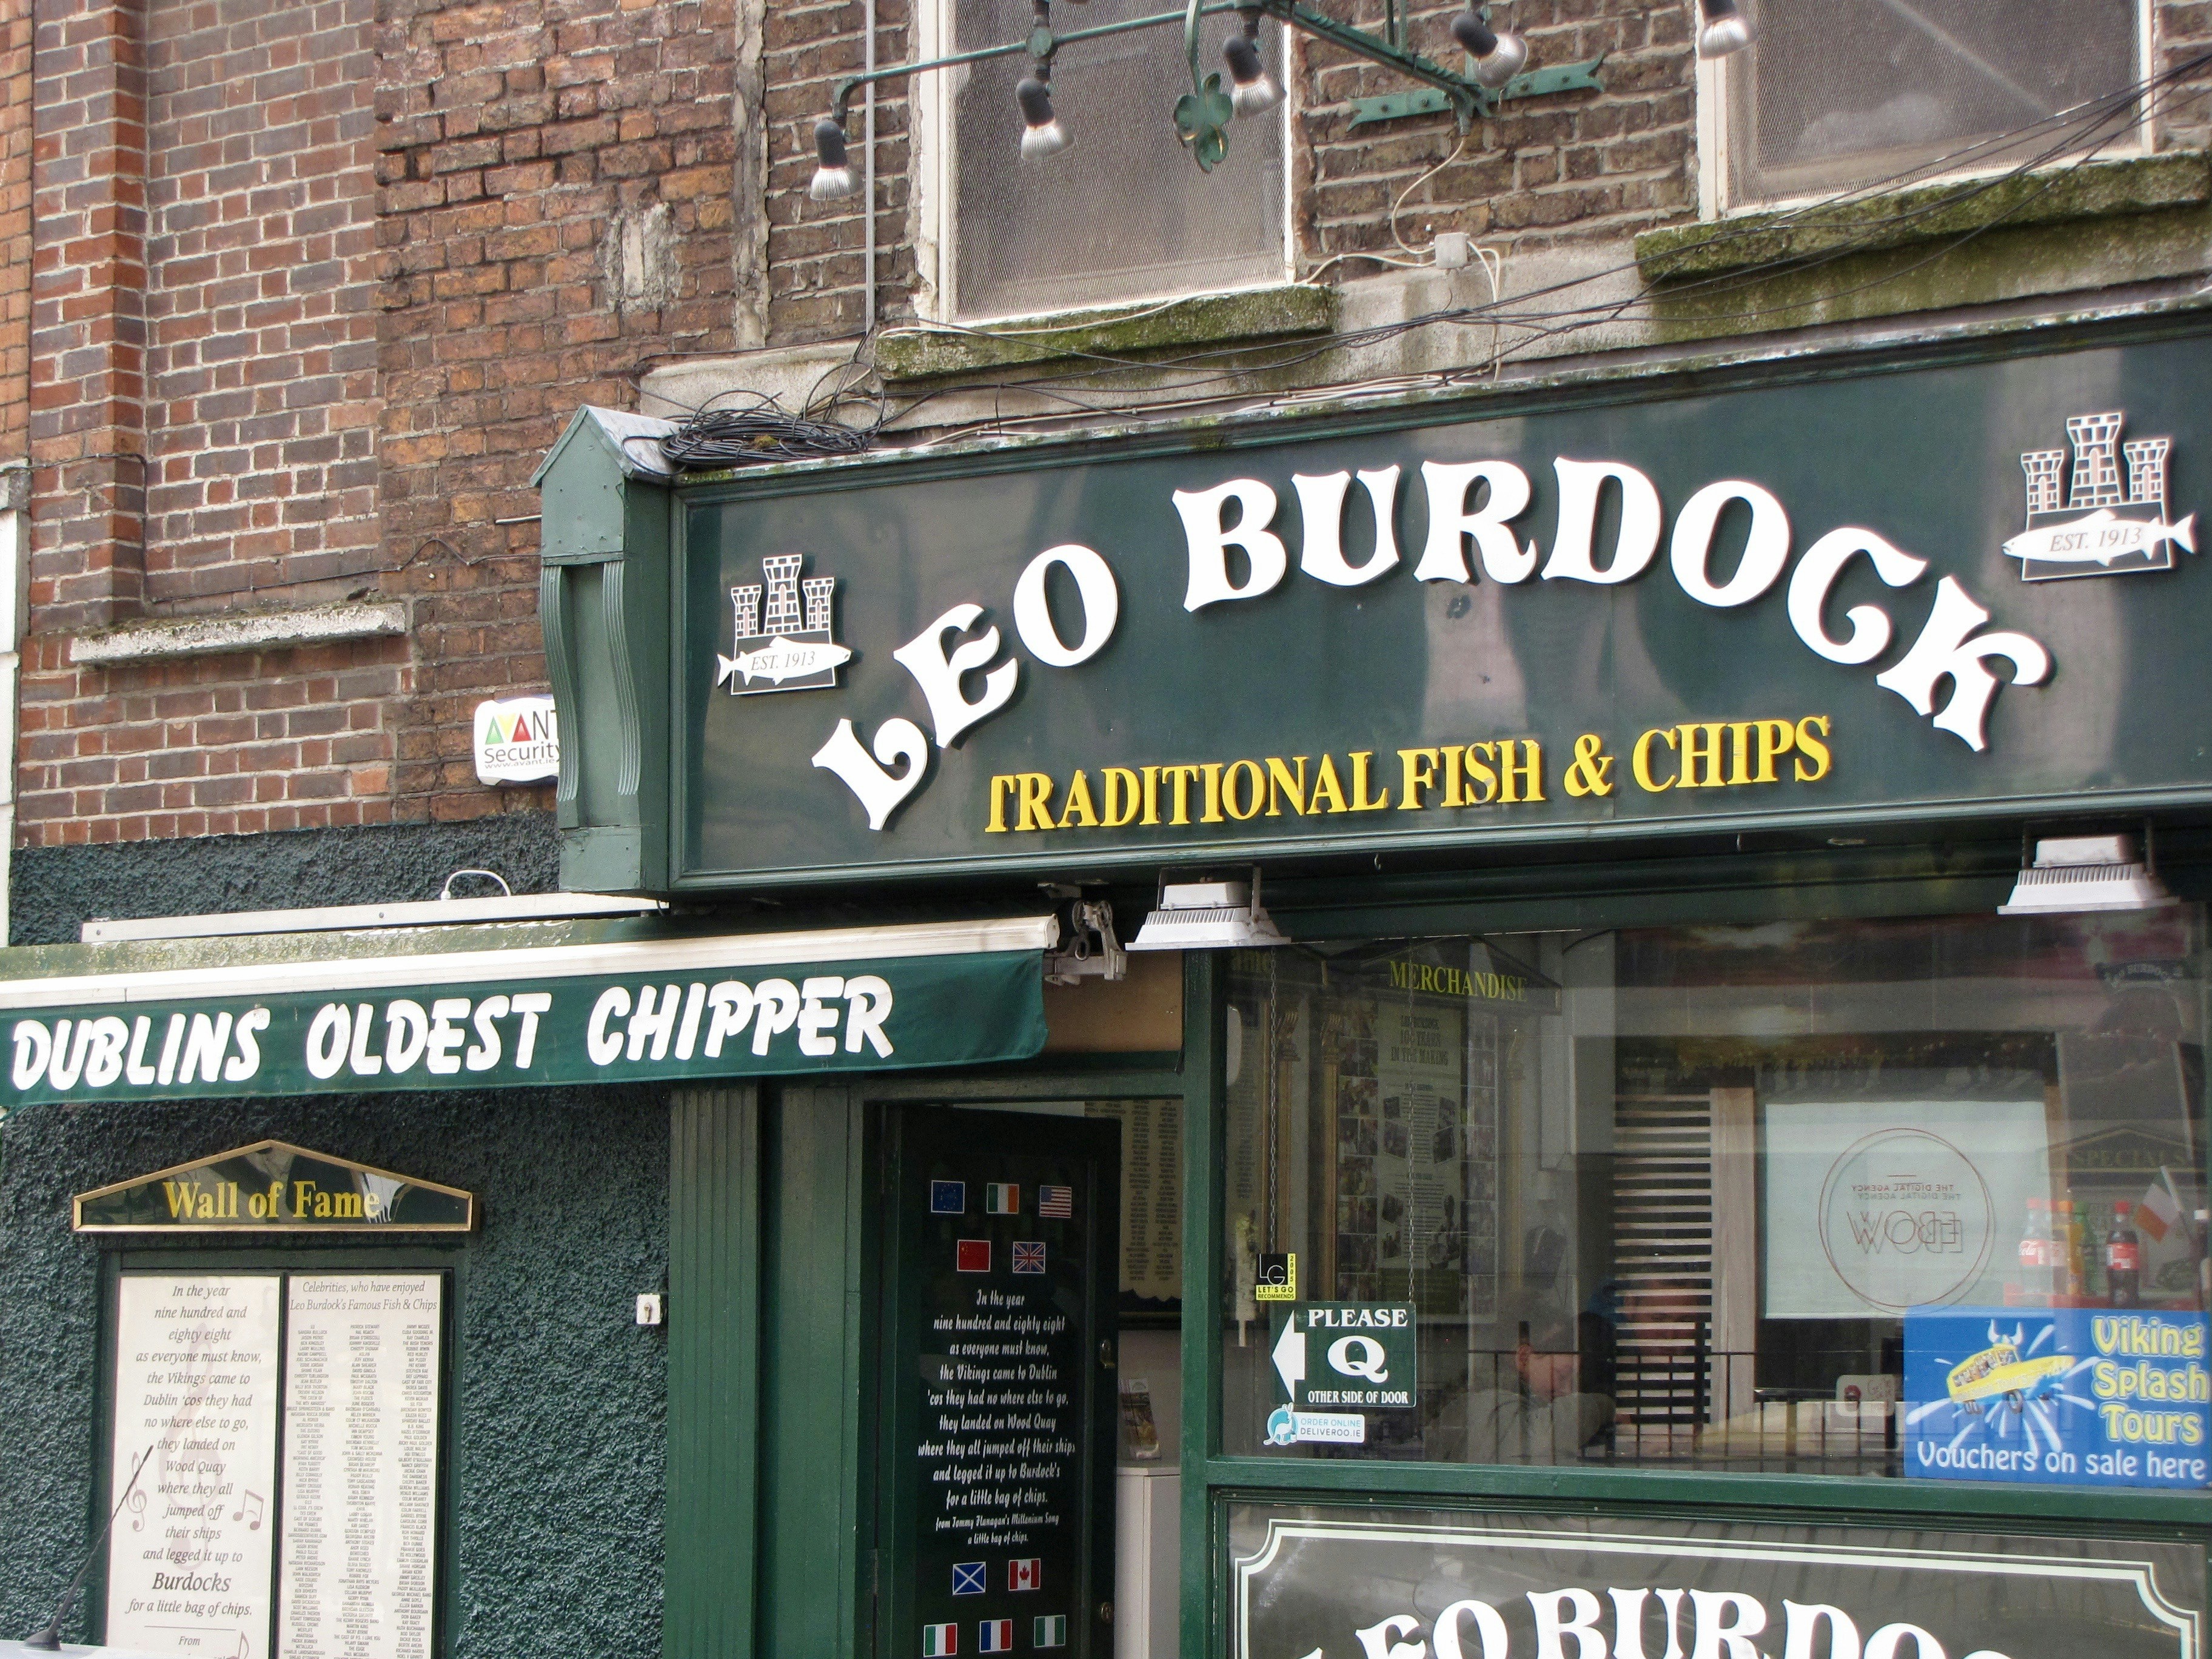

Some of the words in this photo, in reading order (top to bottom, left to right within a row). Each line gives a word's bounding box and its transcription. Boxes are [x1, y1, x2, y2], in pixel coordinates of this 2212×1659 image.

[2049, 532, 2088, 552] EST.
[2098, 527, 2142, 547] 1913
[811, 543, 1118, 831] LEO
[1171, 457, 2053, 752] BURDOCK
[751, 654, 779, 671] EST.
[783, 651, 815, 668] 1913
[484, 759, 555, 769] www.avant.ie
[985, 750, 1389, 833] TRADITIONAL
[1397, 739, 1546, 811] FISH
[1563, 734, 1614, 798] &
[1632, 715, 1832, 793] CHIPS
[1389, 960, 1527, 1002] MERCHANDISE
[12, 1007, 271, 1091] DUBLINS
[306, 992, 552, 1080] OLDEST
[587, 974, 894, 1067] CHIPPER
[163, 1181, 239, 1218] Wall
[248, 1182, 284, 1218] of
[293, 1180, 381, 1218] Fame
[172, 1286, 183, 1296] In
[187, 1285, 203, 1296] the
[203, 1287, 230, 1299] year
[303, 1281, 349, 1293] Celebrities,
[352, 1281, 369, 1292] who
[370, 1281, 390, 1292] have
[392, 1281, 425, 1295] enjoyed
[290, 1299, 305, 1310] Leo
[307, 1299, 346, 1310] Burdock's
[348, 1299, 381, 1310] Famous
[383, 1299, 401, 1310] Fish
[403, 1299, 411, 1309] &
[413, 1299, 437, 1313] Chips
[976, 1289, 987, 1305] In
[990, 1290, 1004, 1305] the
[1006, 1295, 1025, 1309] year
[154, 1307, 177, 1318] nine
[179, 1306, 223, 1318] hundred
[227, 1305, 247, 1318] and
[1307, 1309, 1409, 1327] PLEASE
[933, 1315, 953, 1330] nine
[956, 1314, 992, 1330] hundred
[994, 1315, 1011, 1330] and
[1013, 1315, 1041, 1334] eighty
[1043, 1315, 1065, 1335] eight
[169, 1328, 201, 1343] eighty
[204, 1328, 232, 1343] eight
[2091, 1316, 2204, 1358] Viking
[136, 1353, 149, 1362] as
[152, 1352, 198, 1365] everyone
[201, 1352, 229, 1362] must
[230, 1350, 262, 1364] know,
[950, 1344, 959, 1355] as
[962, 1344, 999, 1359] everyone
[1002, 1340, 1023, 1355] must
[1025, 1340, 1049, 1356] know,
[1327, 1335, 1389, 1384] Q
[147, 1372, 164, 1384] the
[167, 1372, 205, 1387] Vikings
[209, 1374, 236, 1384] came
[240, 1373, 250, 1384] to
[940, 1364, 954, 1379] the
[957, 1364, 990, 1384] Vikings
[993, 1369, 1015, 1379] came
[1017, 1364, 1026, 1379] to
[1029, 1364, 1057, 1379] Dublin
[2092, 1359, 2210, 1403] Splash
[143, 1394, 178, 1406] Dublin
[182, 1396, 202, 1406] 'cos
[205, 1395, 229, 1410] they
[231, 1394, 253, 1406] had
[928, 1389, 943, 1405] 'cos
[946, 1389, 965, 1409] they
[968, 1389, 985, 1405] had
[987, 1393, 997, 1405] no
[1000, 1389, 1024, 1405] where
[1027, 1389, 1043, 1404] else
[1046, 1389, 1054, 1404] to
[1056, 1393, 1068, 1407] go,
[1308, 1390, 1339, 1403] OTHER
[1341, 1390, 1363, 1404] SIDE
[1367, 1391, 1378, 1404] OF
[1381, 1391, 1409, 1404] DOOR
[144, 1418, 157, 1427] no
[161, 1416, 194, 1428] where
[195, 1416, 216, 1428] else
[220, 1418, 230, 1428] to
[232, 1419, 249, 1432] go,
[940, 1414, 959, 1434] they
[961, 1413, 992, 1430] landed
[994, 1419, 1004, 1430] on
[1007, 1413, 1031, 1429] Wood
[1033, 1413, 1056, 1433] Quay
[1300, 1427, 1361, 1437] DELIVEROO.IE
[2099, 1401, 2202, 1446] Tours
[157, 1438, 181, 1453] they
[183, 1438, 220, 1450] landed
[222, 1441, 235, 1450] on
[918, 1439, 943, 1456] where
[946, 1439, 965, 1459] they
[968, 1439, 981, 1455] all
[982, 1438, 1015, 1458] jumped
[1017, 1438, 1030, 1457] off
[1033, 1438, 1053, 1453] their
[1055, 1438, 1076, 1456] ships
[166, 1460, 194, 1472] Wood
[198, 1461, 226, 1475] Quay
[1917, 1440, 2037, 1472] Vouchers
[2045, 1452, 2076, 1473] on
[2085, 1449, 2138, 1476] sale
[2147, 1450, 2206, 1480] here
[933, 1464, 951, 1481] and
[953, 1464, 982, 1484] legged
[985, 1464, 993, 1480] it
[995, 1469, 1005, 1483] up
[1008, 1464, 1017, 1479] to
[1020, 1462, 1060, 1479] Burdock's
[158, 1482, 189, 1495] where
[192, 1483, 216, 1498] they
[218, 1483, 233, 1495] all
[946, 1489, 959, 1510] for
[961, 1495, 967, 1506] a
[970, 1489, 992, 1505] little
[994, 1489, 1010, 1508] bag
[1013, 1487, 1022, 1507] of
[1024, 1487, 1048, 1506] chips.
[162, 1504, 204, 1519] jumped
[208, 1504, 225, 1520] off
[165, 1526, 190, 1538] their
[193, 1527, 222, 1542] ships
[143, 1548, 164, 1560] and
[166, 1549, 200, 1564] legged
[204, 1549, 212, 1561] it
[215, 1552, 229, 1564] up
[232, 1551, 243, 1562] to
[152, 1572, 232, 1592] Burdocks
[125, 1598, 144, 1614] for
[147, 1601, 155, 1611] a
[157, 1600, 183, 1612] little
[185, 1600, 204, 1616] bag
[208, 1601, 222, 1617] of
[222, 1603, 252, 1618] chips.
[178, 1637, 201, 1646] From
